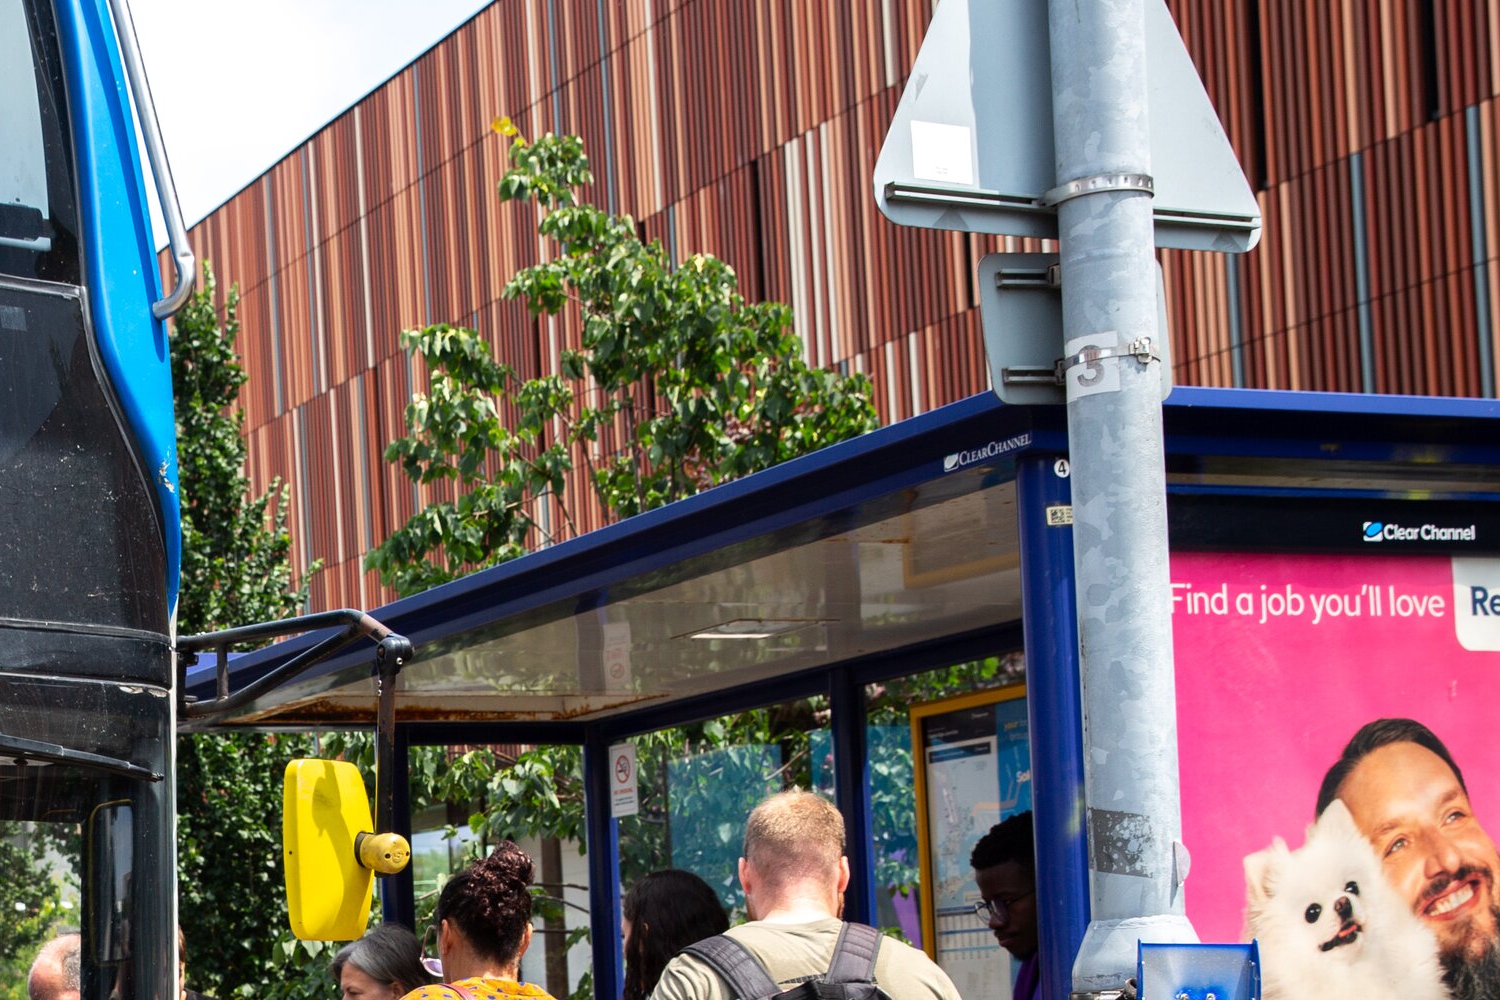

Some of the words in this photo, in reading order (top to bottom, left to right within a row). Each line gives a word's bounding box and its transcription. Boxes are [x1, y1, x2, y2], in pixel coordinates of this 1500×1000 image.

[1058, 461, 1067, 475] 4
[1383, 523, 1419, 541] Clear
[1420, 524, 1476, 541] Channel
[1170, 583, 1228, 616] Find
[1235, 591, 1254, 616] a
[1259, 584, 1305, 625] job
[1390, 585, 1446, 618] love
